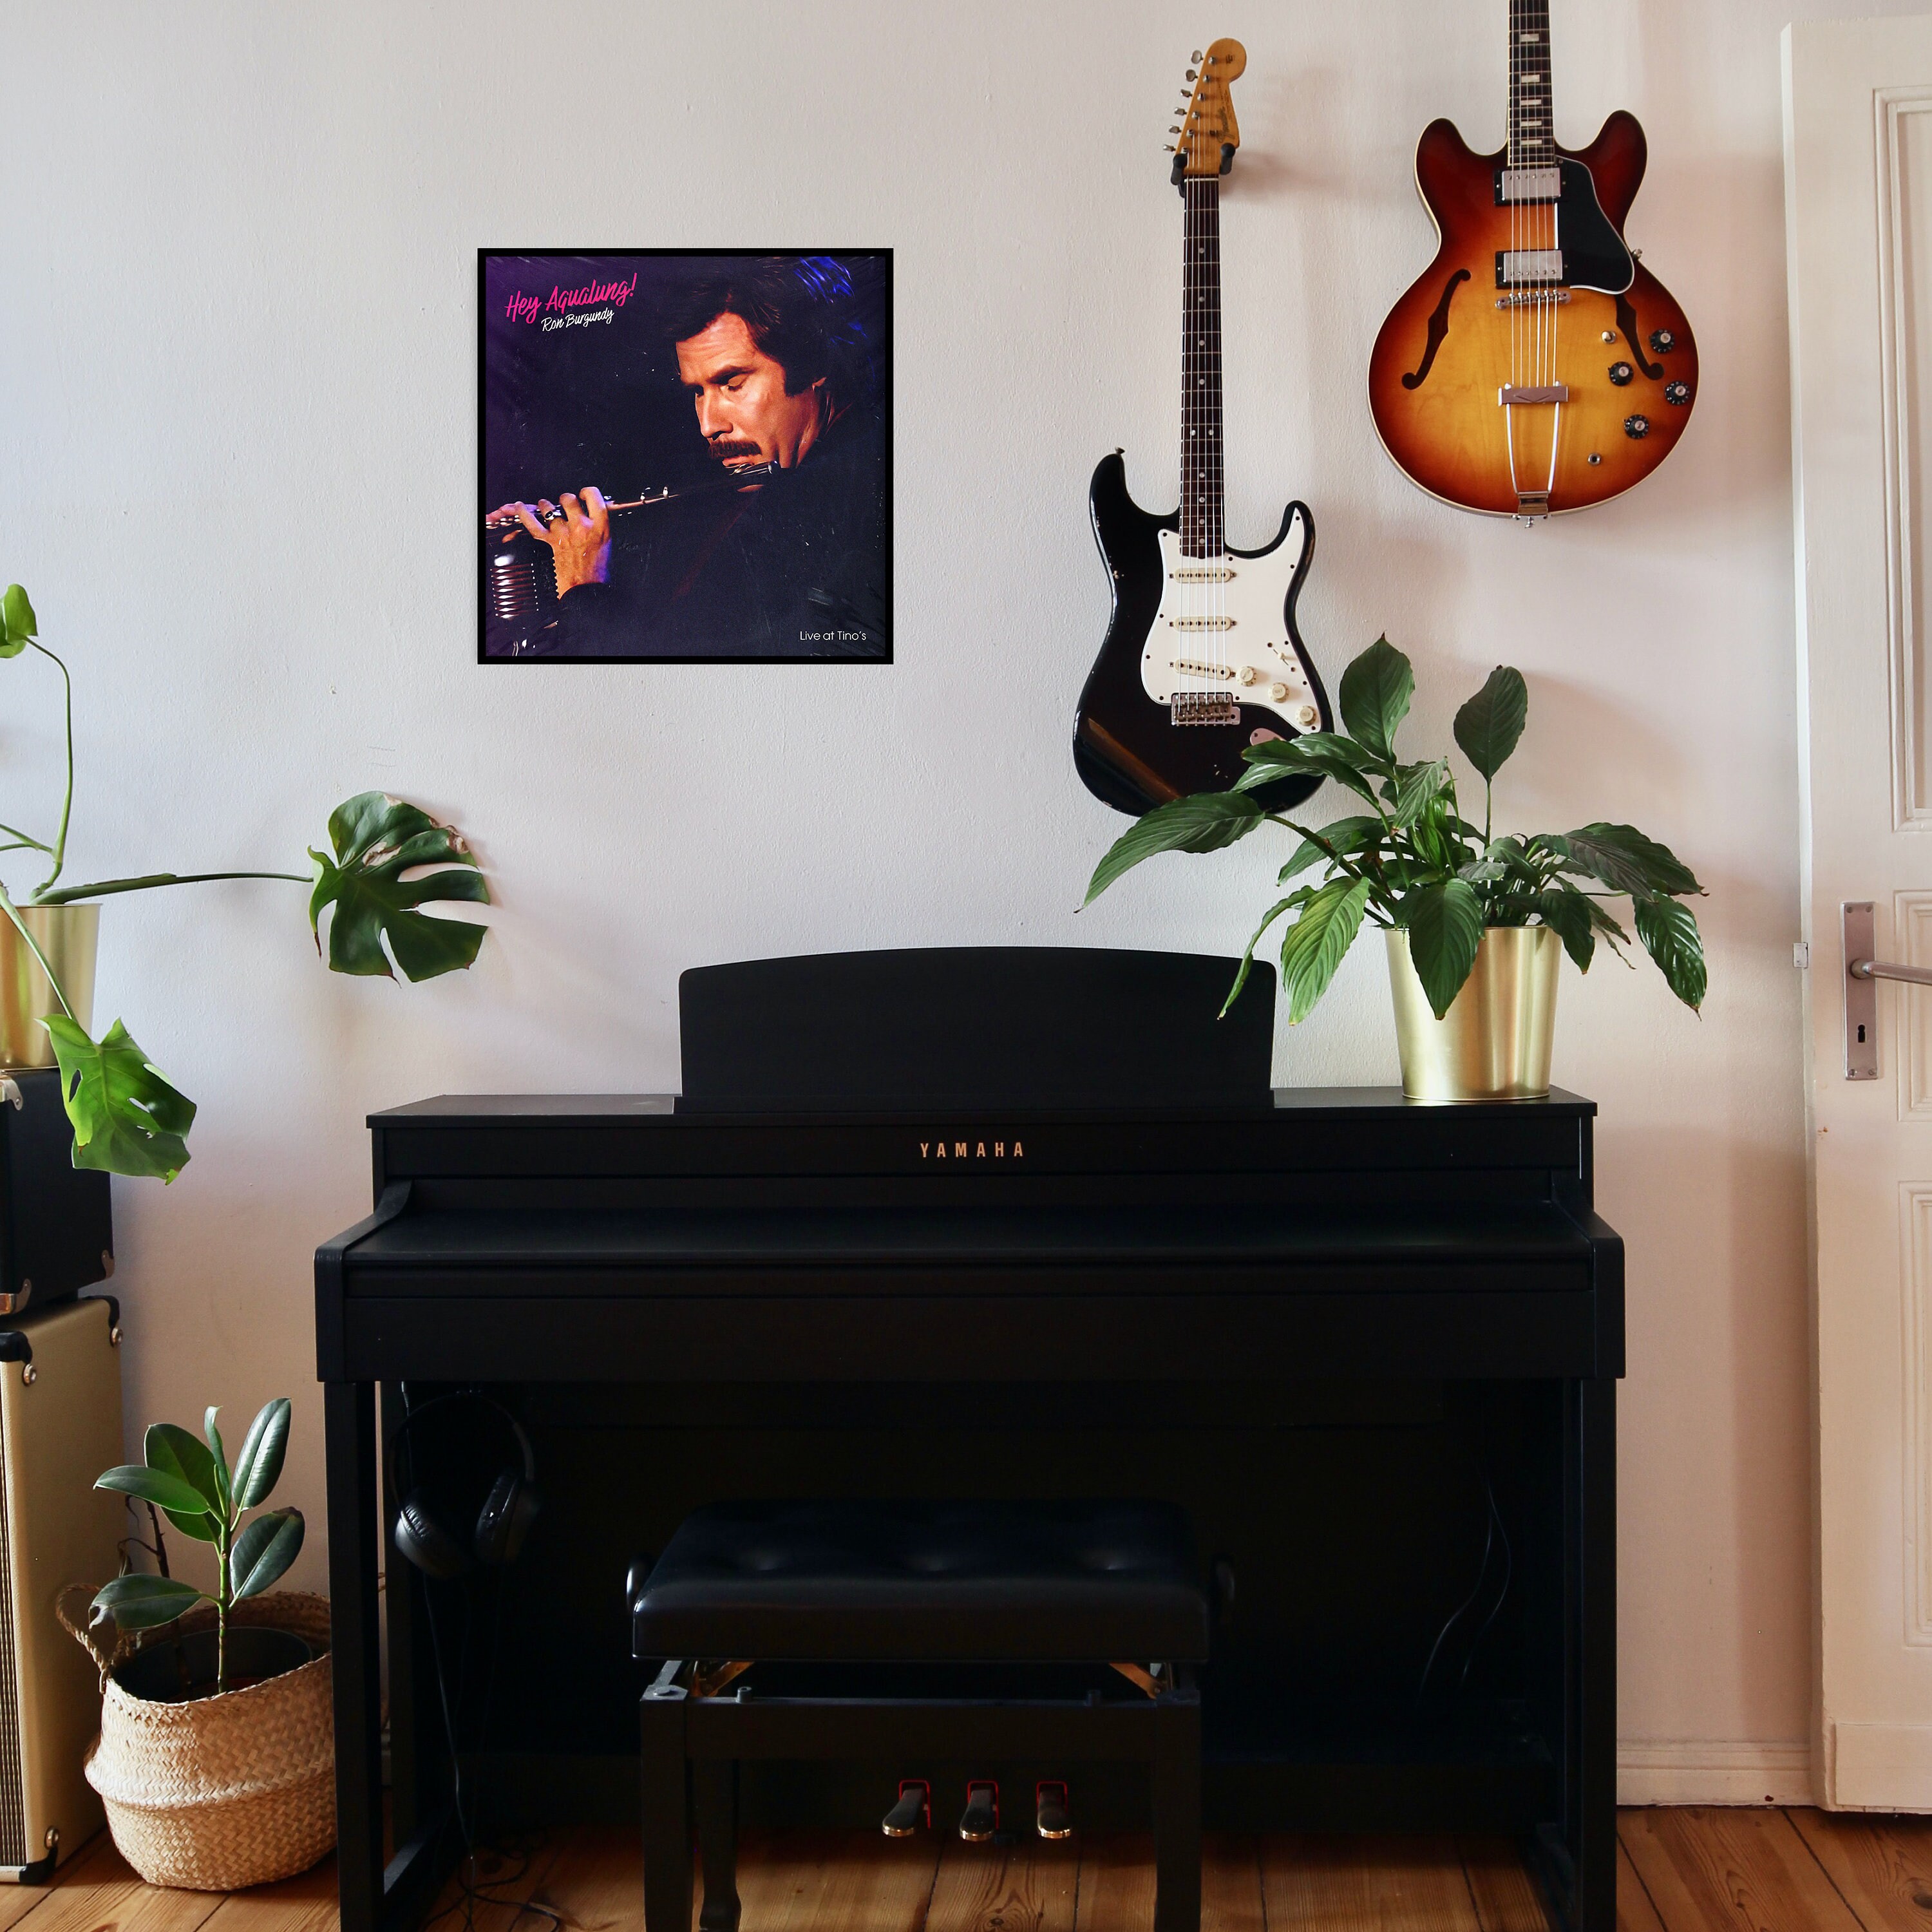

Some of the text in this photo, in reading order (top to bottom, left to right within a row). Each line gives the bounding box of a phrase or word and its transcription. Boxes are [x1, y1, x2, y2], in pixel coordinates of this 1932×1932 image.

[504, 272, 638, 324] Hey Aqualung!
[541, 307, 614, 332] Ron Burgundy
[800, 630, 867, 641] Live at Tino's
[920, 1142, 1023, 1158] YAMAHA
